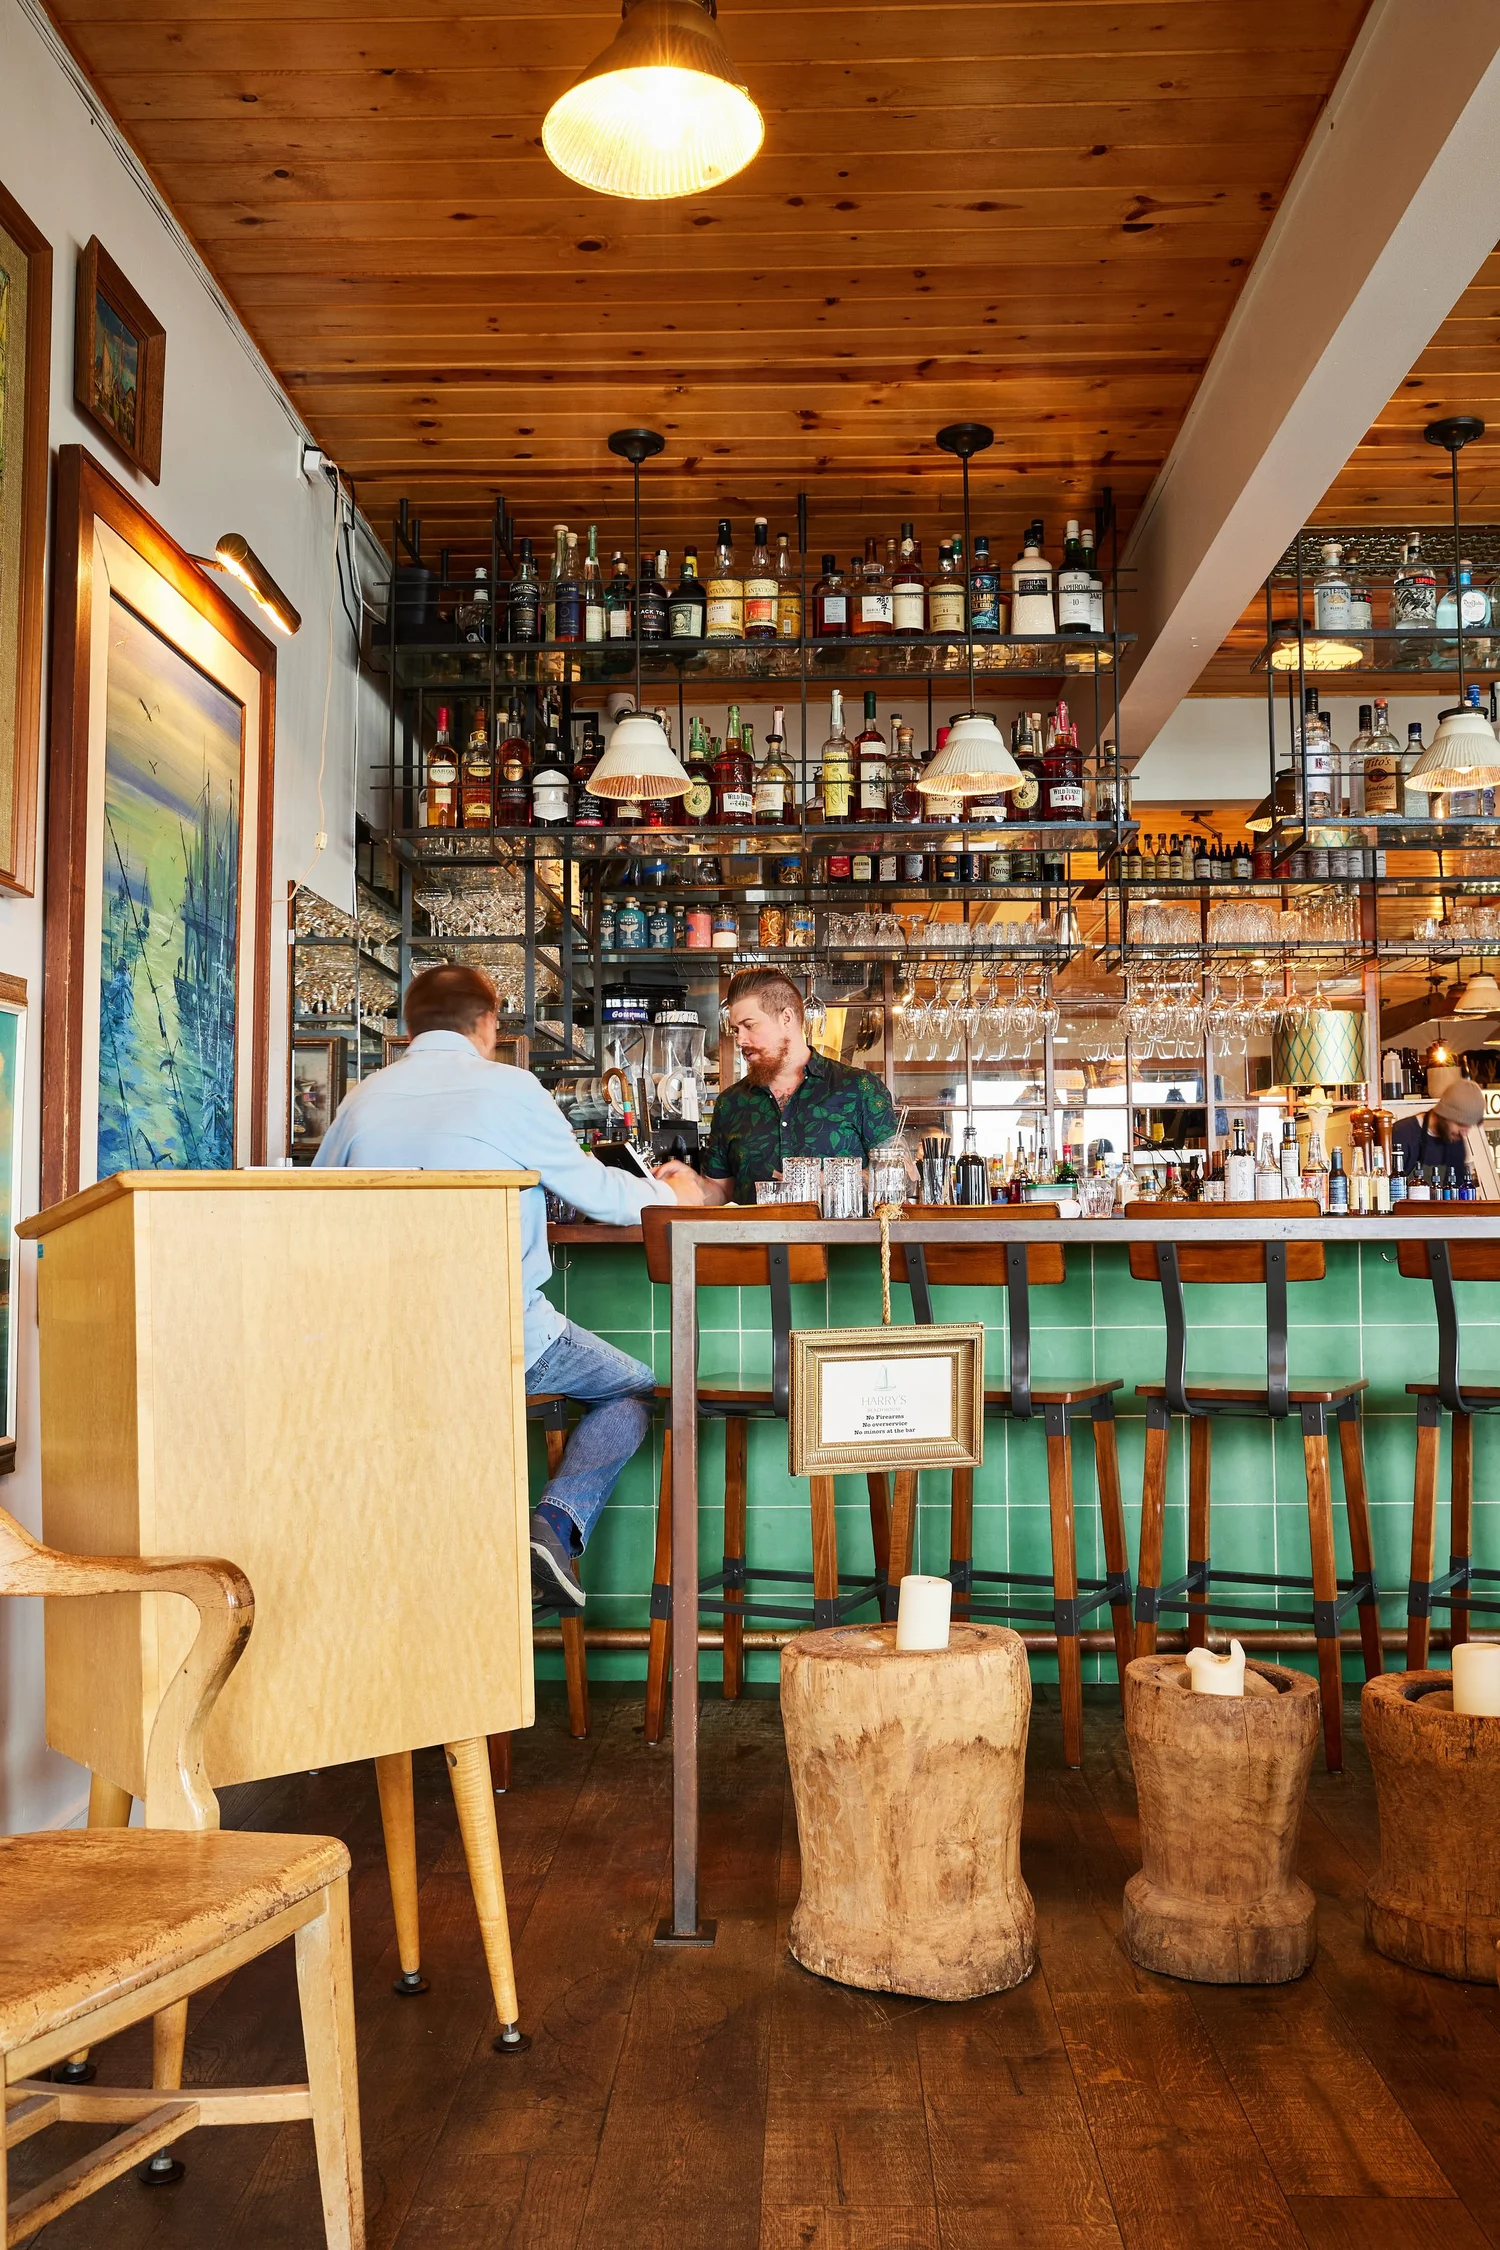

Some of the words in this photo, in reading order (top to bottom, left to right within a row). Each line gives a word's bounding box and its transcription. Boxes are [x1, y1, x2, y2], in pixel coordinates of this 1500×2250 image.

[1072, 598, 1080, 606] 10
[1366, 757, 1391, 768] Tito's
[861, 1395, 907, 1406] HARRY'S
